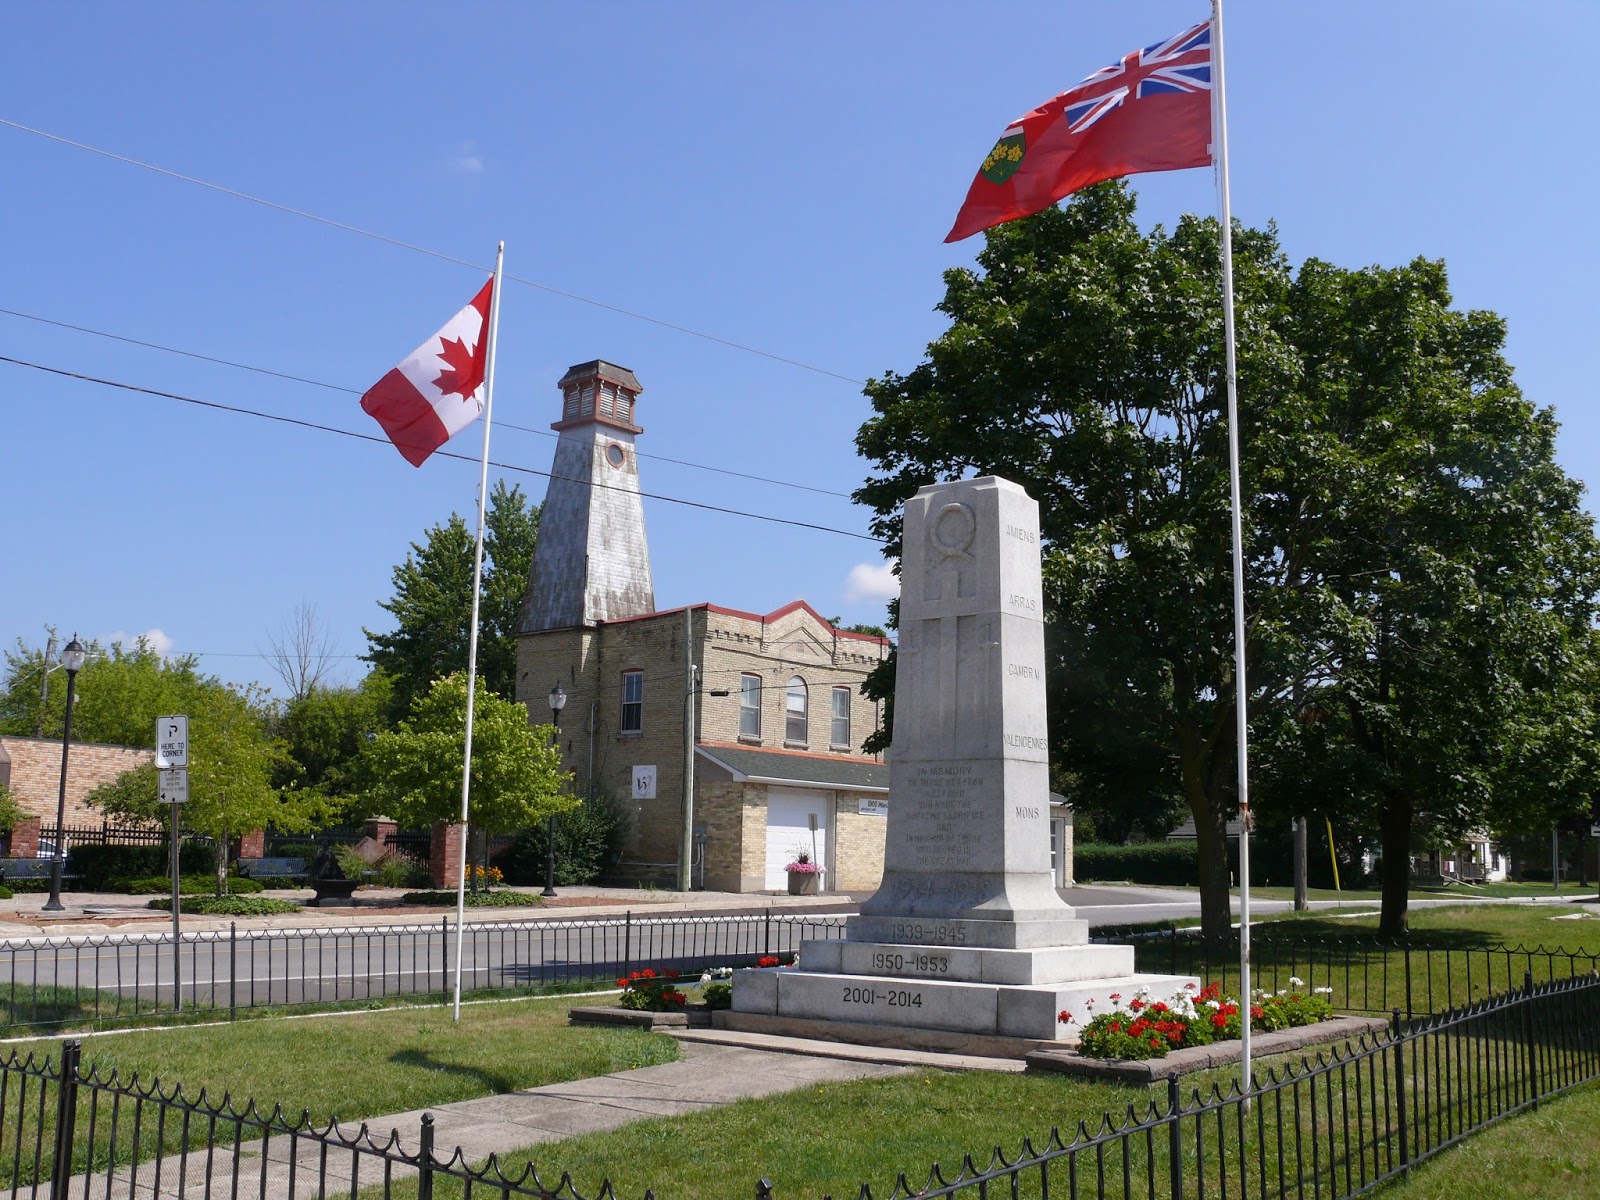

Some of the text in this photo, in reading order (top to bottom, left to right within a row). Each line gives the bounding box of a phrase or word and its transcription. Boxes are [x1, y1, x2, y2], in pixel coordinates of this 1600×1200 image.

[1006, 525, 1034, 543] AMIENS
[1009, 594, 1035, 611] ARRAS
[1003, 734, 1048, 750] VALENCIENNES
[917, 766, 972, 776] IN MEMORY
[1015, 807, 1040, 819] MONS
[892, 923, 966, 942] 1939-1945
[872, 952, 948, 973] 1950-1953
[843, 987, 923, 1008] 2001-2014
